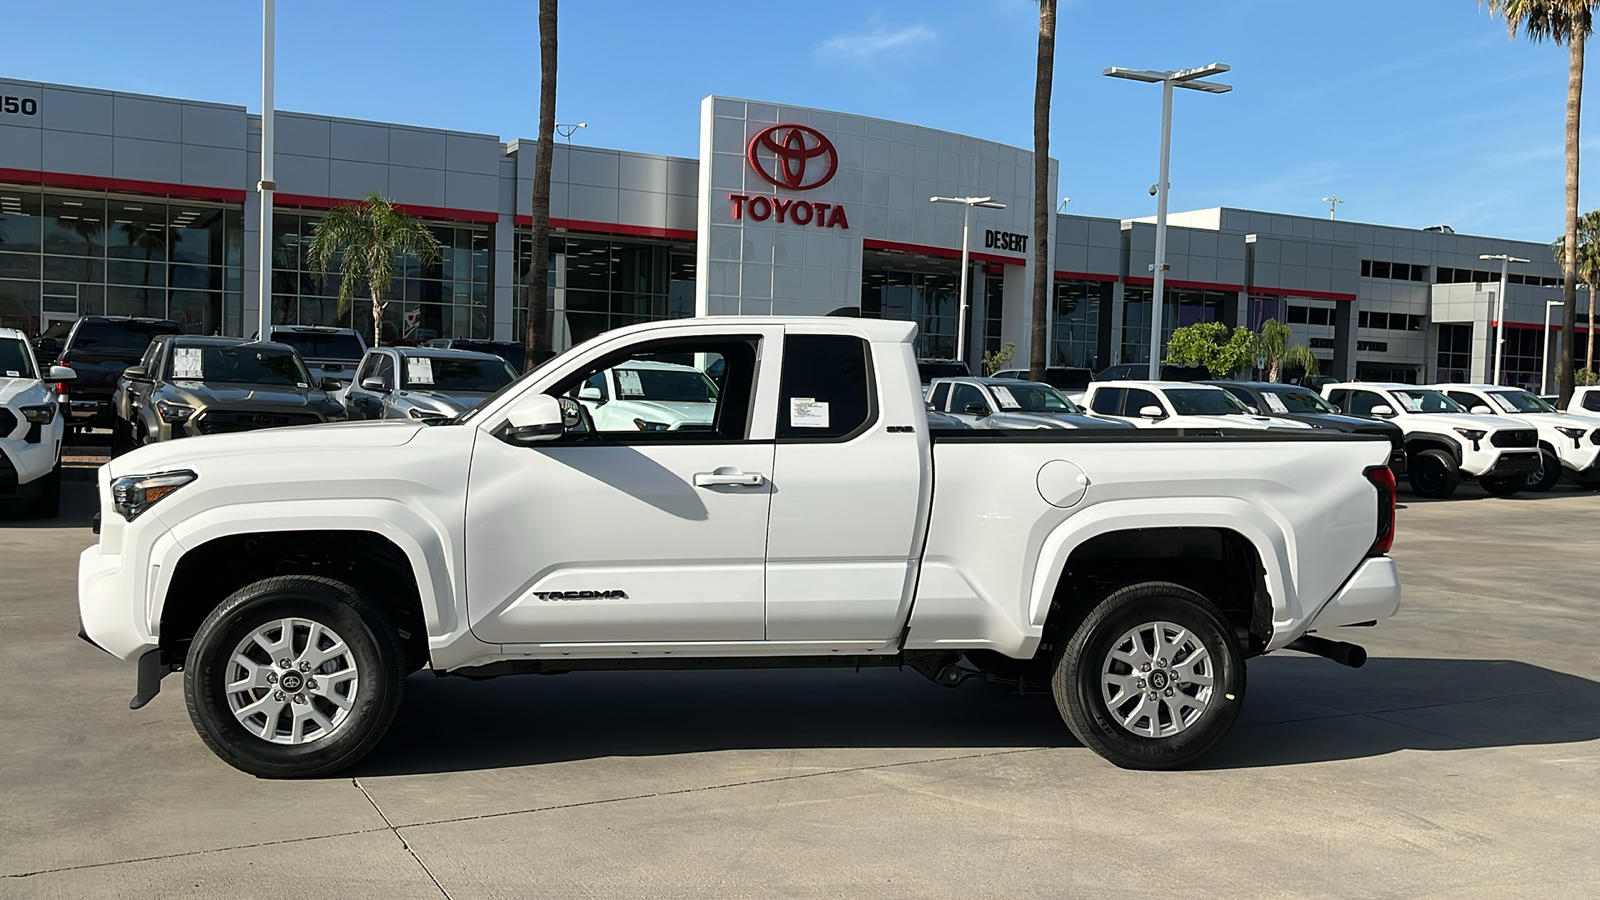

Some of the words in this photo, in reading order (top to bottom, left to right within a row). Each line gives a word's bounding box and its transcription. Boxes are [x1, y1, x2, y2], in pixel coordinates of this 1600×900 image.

[728, 193, 849, 229] TOYOTA
[985, 229, 1029, 253] DESERT
[532, 589, 630, 602] TACOMA
